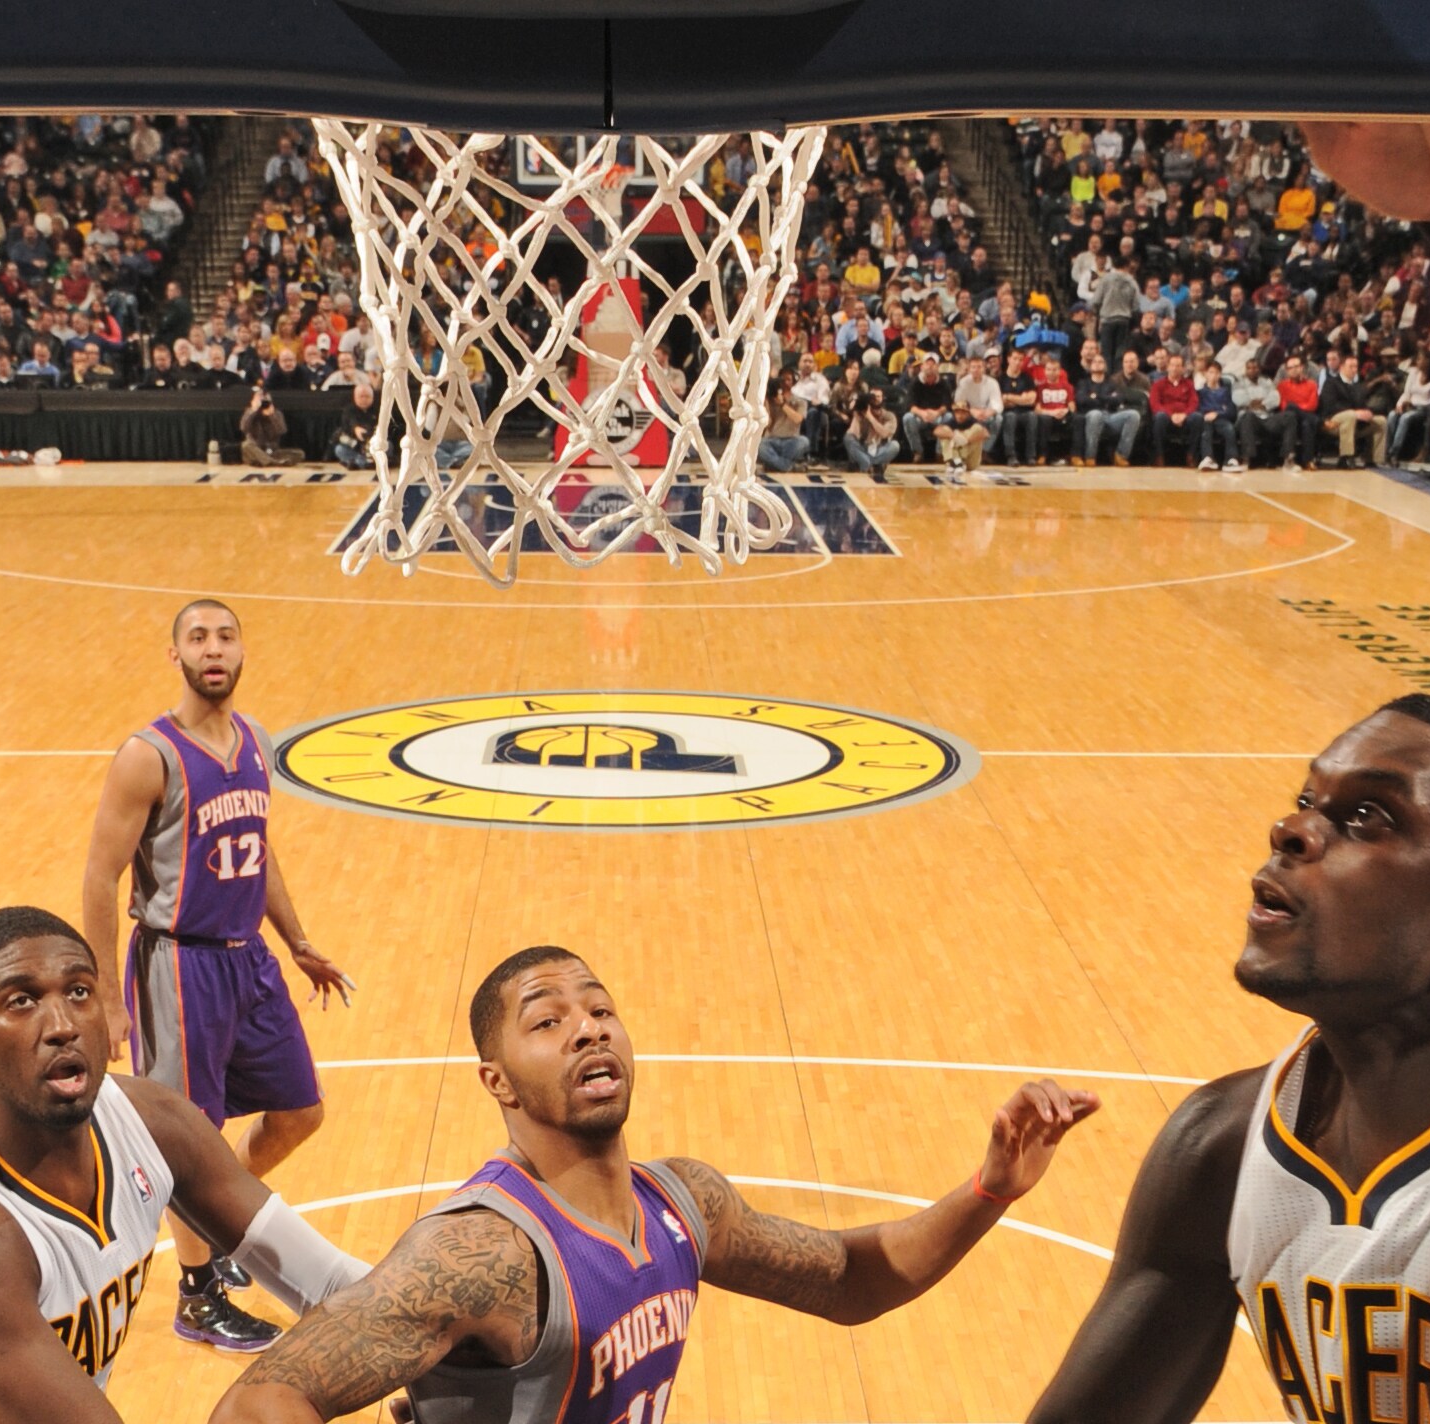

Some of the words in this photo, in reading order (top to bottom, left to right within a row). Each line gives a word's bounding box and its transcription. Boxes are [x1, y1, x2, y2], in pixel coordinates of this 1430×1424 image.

[217, 831, 261, 880] 12
[50, 1247, 155, 1379] ACE
[588, 1288, 698, 1400] PHOENI
